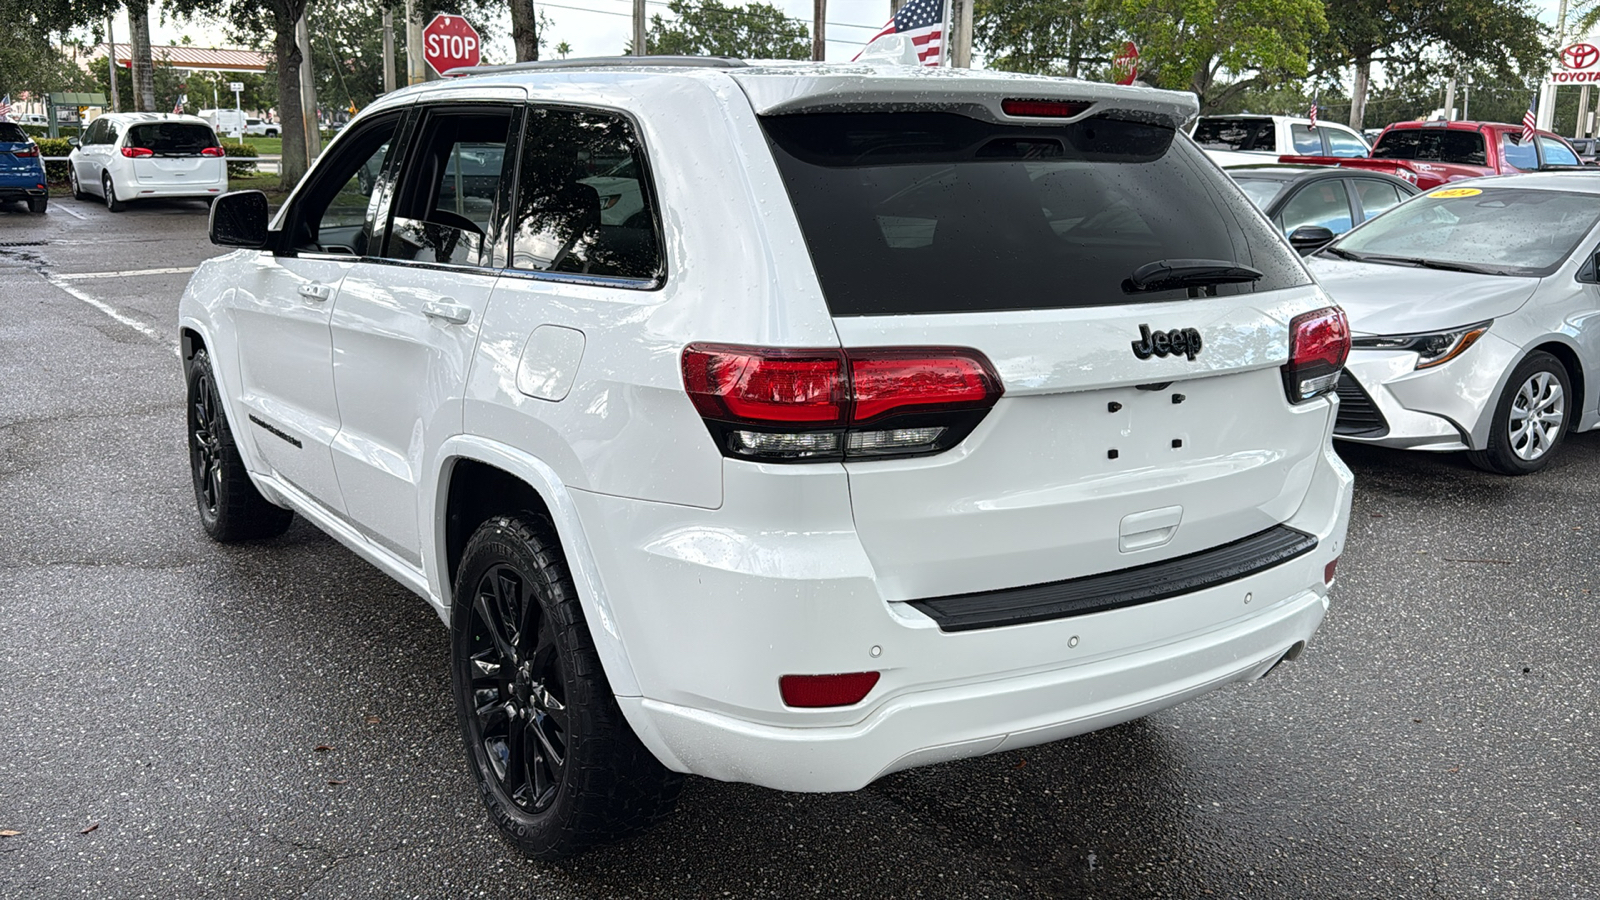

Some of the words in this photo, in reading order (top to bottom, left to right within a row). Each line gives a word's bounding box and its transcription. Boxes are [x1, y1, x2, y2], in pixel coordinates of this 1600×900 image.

[428, 33, 476, 60] STOP
[1551, 71, 1600, 82] TOYOTA
[1413, 163, 1431, 171] TRD
[1131, 323, 1203, 361] Jeep
